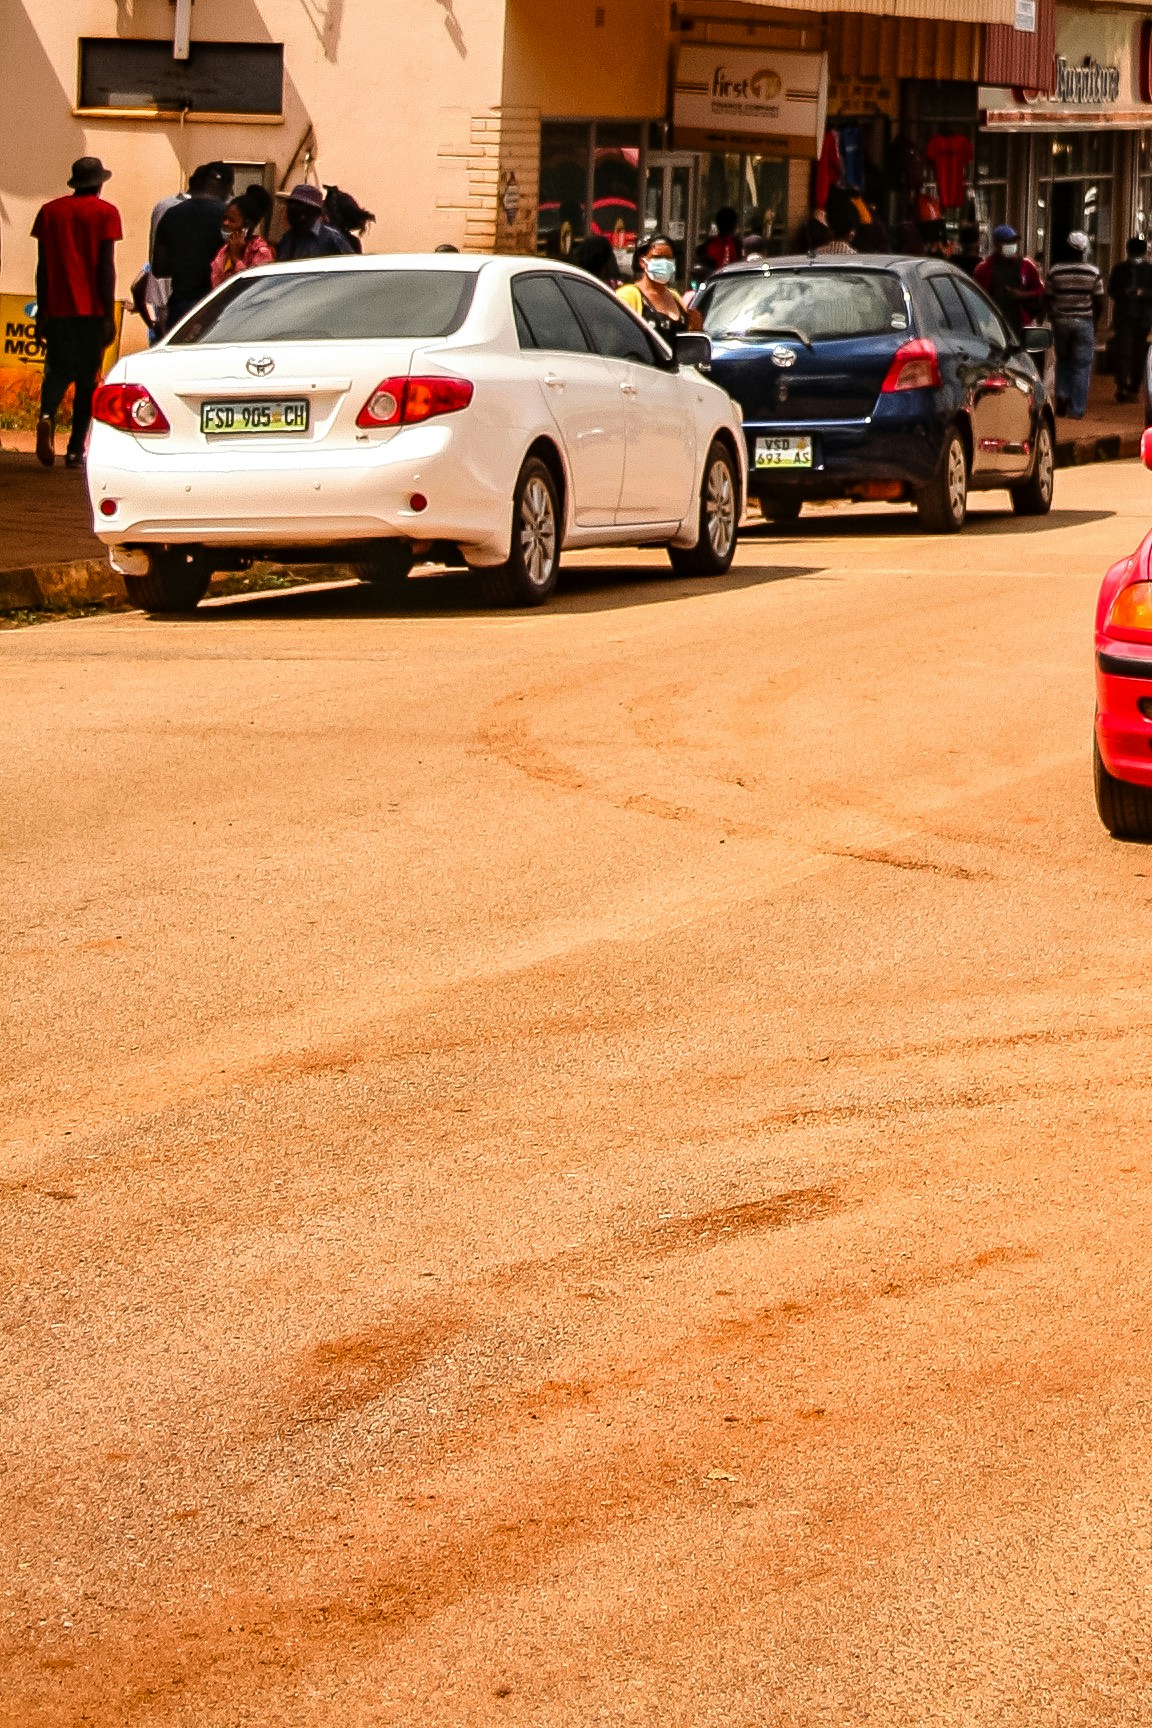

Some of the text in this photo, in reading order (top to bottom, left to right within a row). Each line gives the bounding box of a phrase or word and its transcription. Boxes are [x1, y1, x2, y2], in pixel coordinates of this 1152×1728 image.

[712, 65, 750, 99] first
[242, 406, 271, 427] 905
[284, 405, 304, 426] CH
[765, 439, 790, 451] VSD
[793, 451, 811, 464] AS
